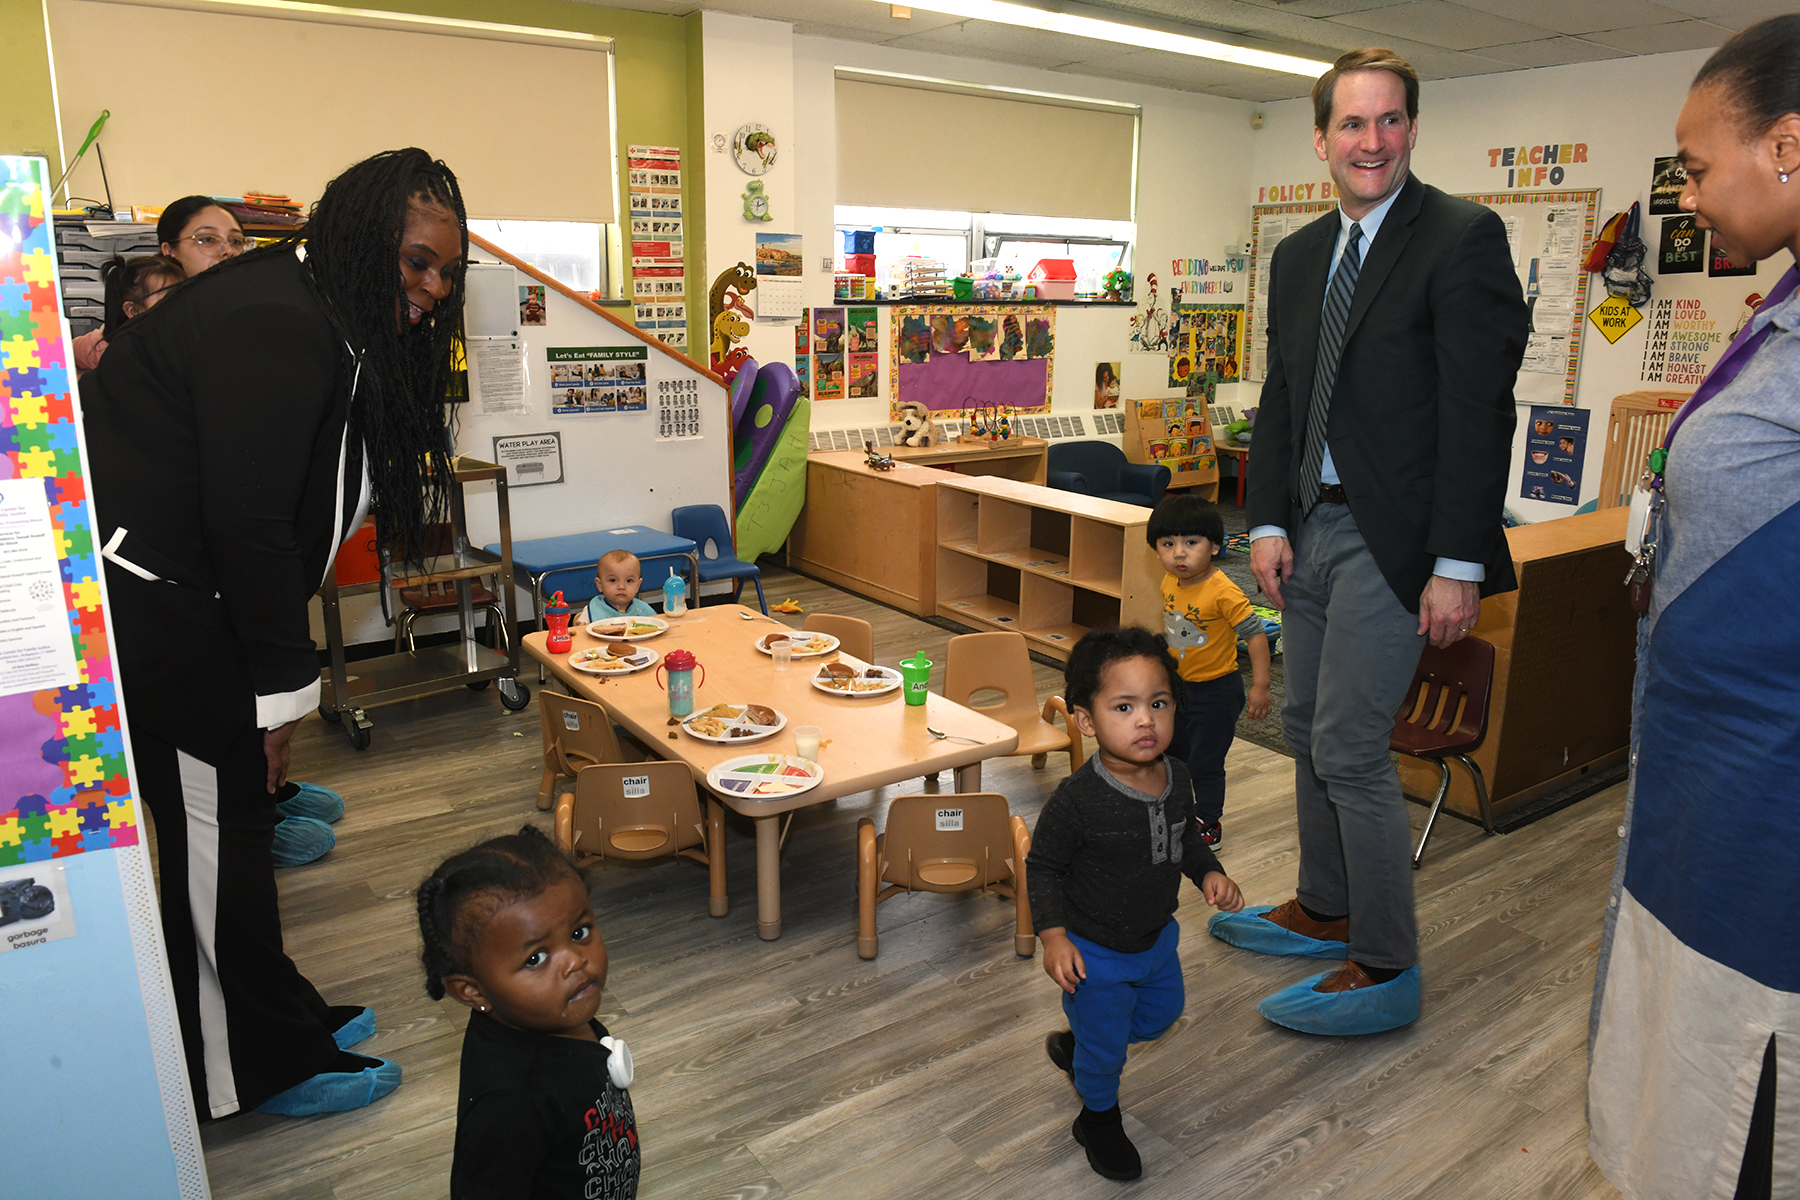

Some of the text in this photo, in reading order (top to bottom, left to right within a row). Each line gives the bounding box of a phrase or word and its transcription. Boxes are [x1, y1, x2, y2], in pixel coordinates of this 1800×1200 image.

[1488, 143, 1588, 167] TEACHER
[1508, 166, 1565, 188] INFO
[1666, 167, 1689, 180] I CA
[1258, 182, 1340, 203] POLICY BO
[1656, 180, 1687, 200] alway
[1670, 229, 1695, 240] can
[1674, 238, 1692, 247] DO
[1665, 251, 1697, 263] BEST
[1172, 258, 1209, 276] READING
[1225, 258, 1244, 273] YOU
[1181, 280, 1222, 294] EVERYWHERE!
[1650, 299, 1701, 310] I AM KIND
[1599, 306, 1631, 316] KIDS AT
[1649, 310, 1707, 320] I AM LOVED
[1602, 317, 1626, 328] WORK
[1648, 320, 1716, 330] I AM WORTHY
[1646, 330, 1722, 343] I AM AWESOME
[1645, 341, 1709, 352] I AM STRONG
[1643, 351, 1700, 363] I AM BRAVE
[1642, 361, 1707, 374] I AM HONEST
[1641, 372, 1707, 385] I AM CREATIV
[499, 441, 521, 449] WATER
[563, 712, 578, 720] chair
[623, 777, 647, 786] chair
[625, 787, 645, 795] silla
[938, 809, 963, 817] chair
[7, 927, 48, 942] garbage
[13, 937, 47, 949] basura
